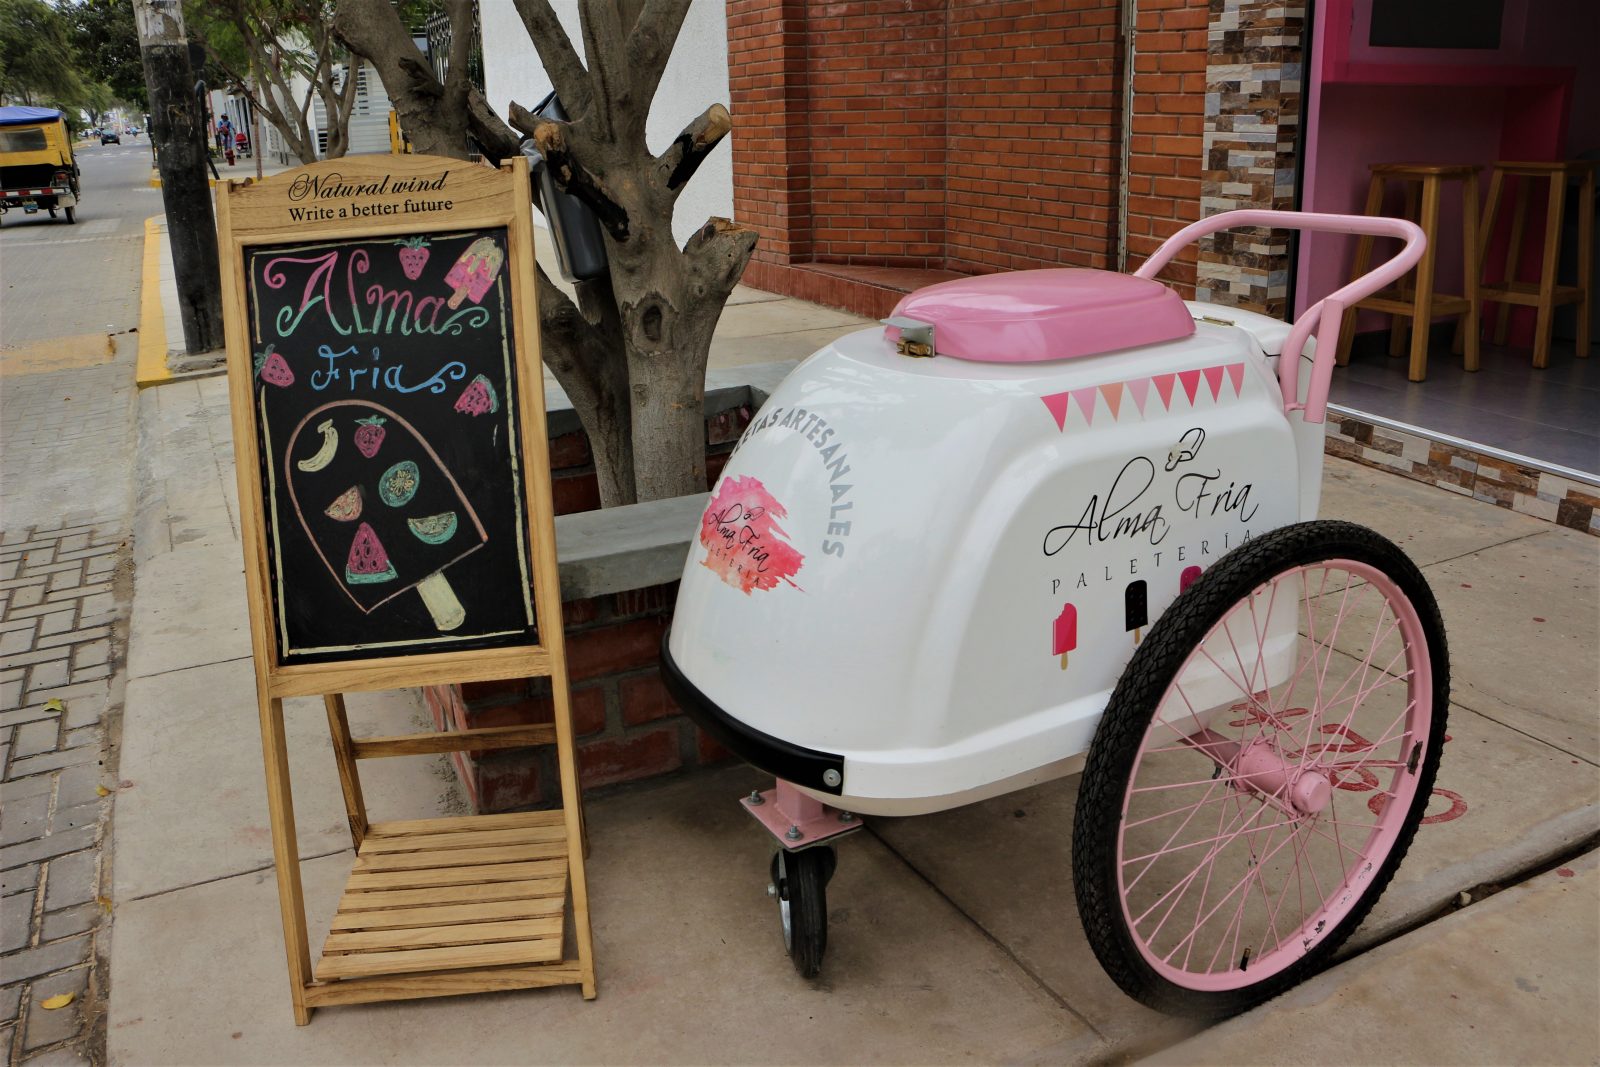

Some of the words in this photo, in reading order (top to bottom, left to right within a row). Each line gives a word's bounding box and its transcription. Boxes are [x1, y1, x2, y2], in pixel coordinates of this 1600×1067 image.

[288, 172, 390, 201] Natural
[392, 170, 449, 194] wind
[288, 205, 334, 222] Write
[338, 207, 347, 218] a
[351, 203, 399, 217] better
[404, 199, 453, 214] future
[263, 249, 490, 338] Alma
[310, 344, 467, 394] Fria
[778, 408, 854, 559] ARTESANALES
[1043, 456, 1171, 556] Alma
[1175, 468, 1260, 523] Fria
